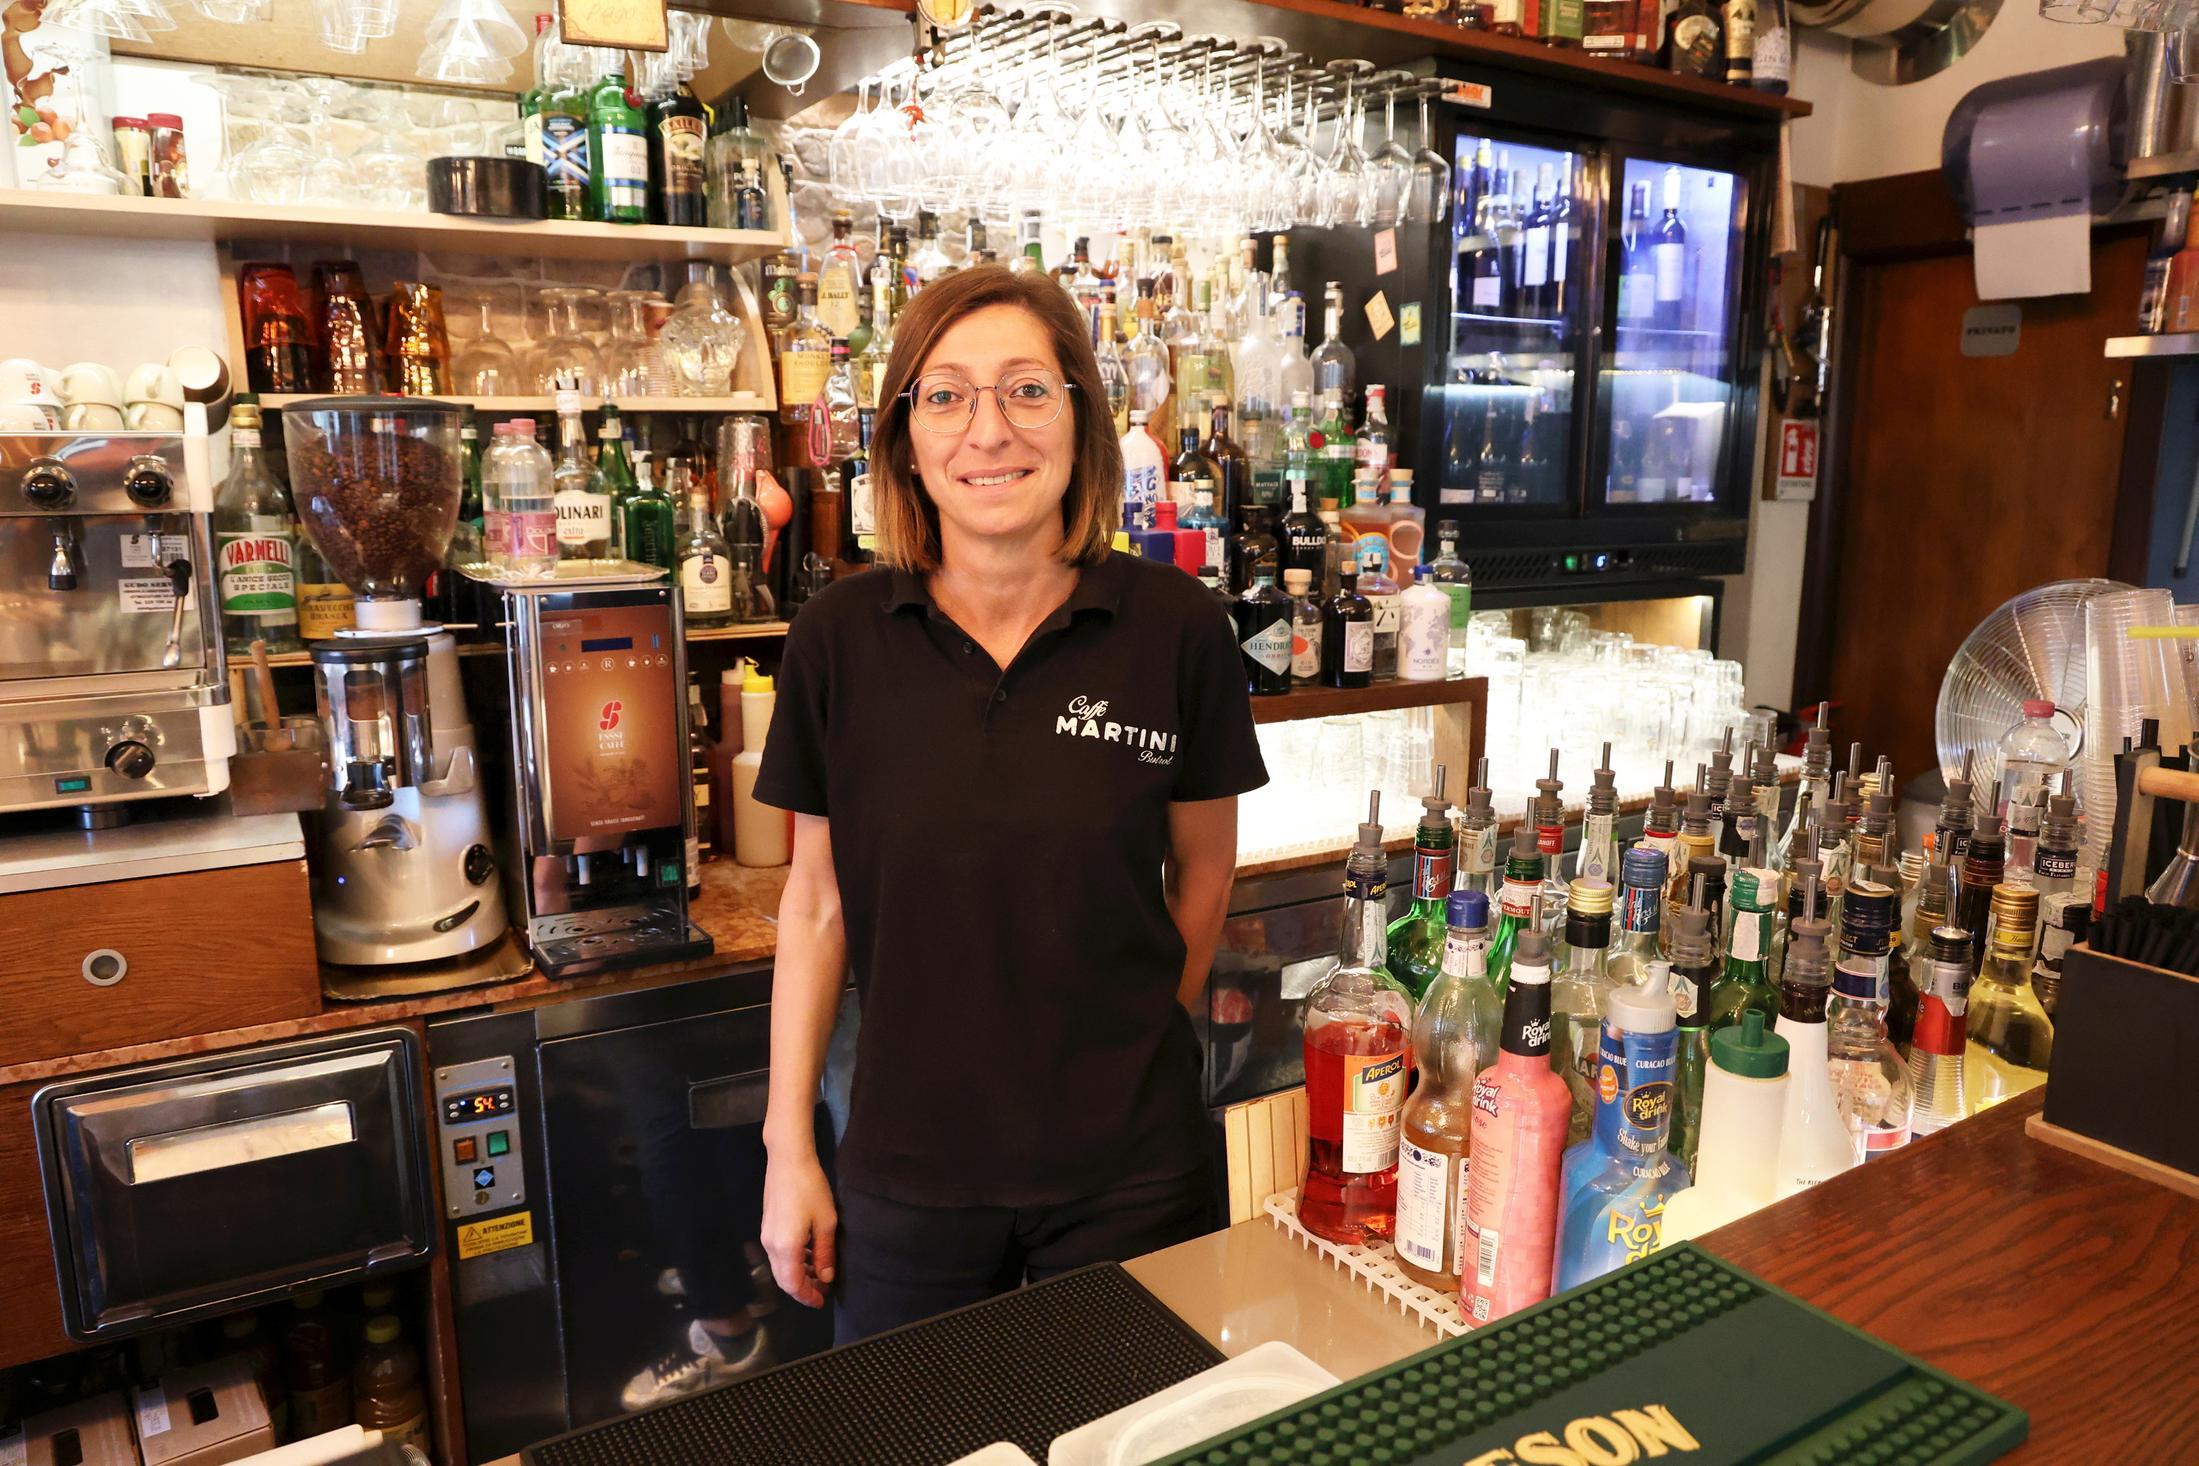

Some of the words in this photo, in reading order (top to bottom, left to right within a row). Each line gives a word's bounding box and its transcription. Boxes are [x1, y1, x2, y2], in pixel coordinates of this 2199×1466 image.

[1291, 535, 1327, 546] BULLDO
[226, 540, 290, 566] VARNELLI
[1055, 715, 1177, 753] MARTINI
[1138, 750, 1174, 765] Bistrot
[2041, 859, 2077, 869] ICEBER
[1365, 1060, 1401, 1082] APEROL
[1635, 1058, 1665, 1069] CURACAO
[1473, 1079, 1498, 1100] Royal
[1632, 1091, 1666, 1113] Royal
[1639, 1103, 1669, 1121] drink
[1617, 1128, 1641, 1153] Shake
[1640, 1141, 1658, 1157] your
[482, 1218, 526, 1235] ATTENZIONE
[1607, 1208, 1662, 1249] Roy
